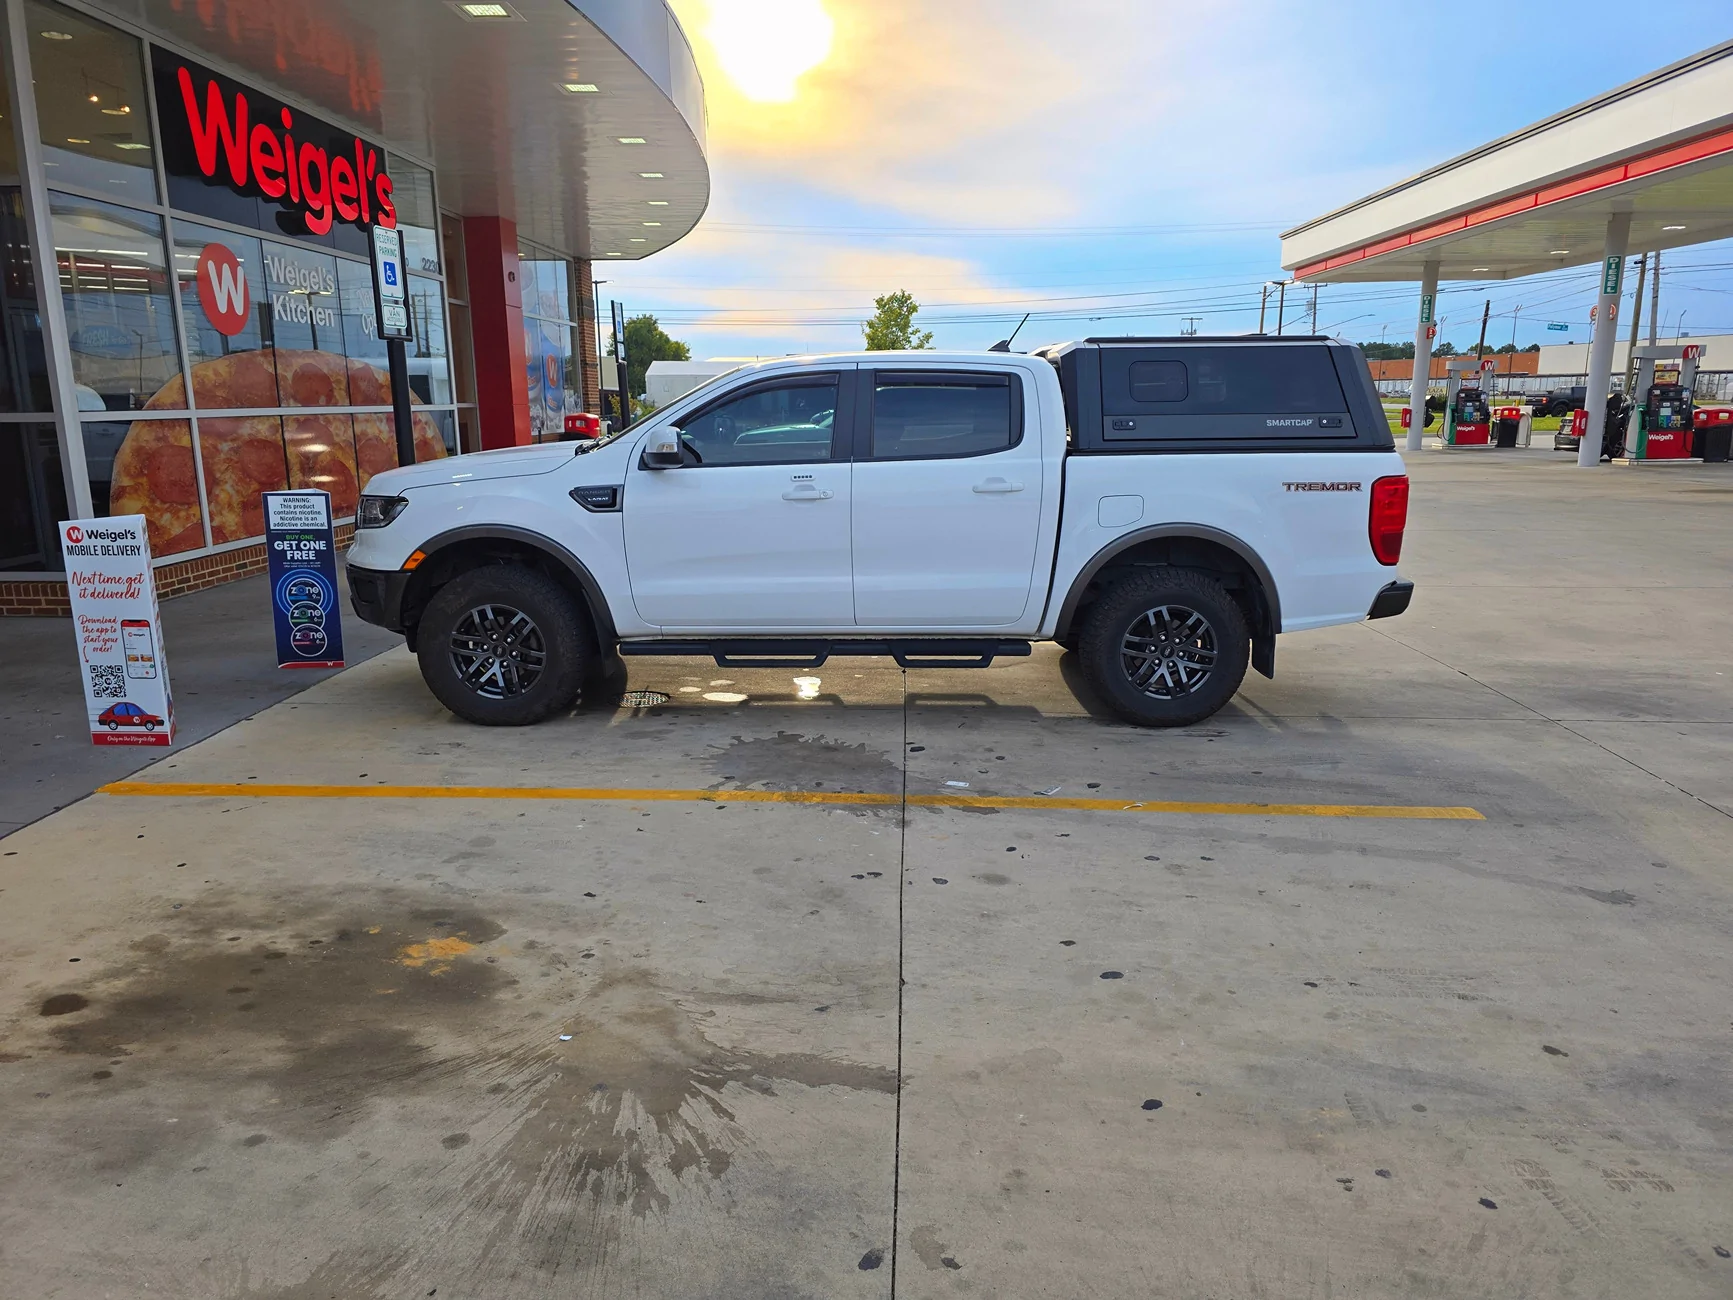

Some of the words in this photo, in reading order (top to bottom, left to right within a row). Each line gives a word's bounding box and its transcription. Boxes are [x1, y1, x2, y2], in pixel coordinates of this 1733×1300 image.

[178, 67, 397, 235] Weigel's
[376, 233, 398, 246] RESERVED
[379, 245, 397, 258] PARKING
[267, 255, 335, 293] Weigel's
[1606, 257, 1619, 293] DIESEL
[208, 260, 244, 315] W
[272, 294, 335, 327] Kitchen
[1422, 295, 1431, 322] DIESEL
[1688, 347, 1700, 359] W
[1485, 362, 1494, 371] W
[1266, 419, 1313, 427] SMARTCAP
[1282, 482, 1362, 492] TREMOR
[71, 529, 82, 540] W
[86, 529, 136, 542] Weigel's
[66, 545, 99, 556] MOBILE
[101, 545, 141, 556] DELIVERY
[274, 541, 298, 550] GET
[300, 541, 327, 550] ONE
[286, 551, 316, 560] FREE
[72, 571, 96, 586] Next
[124, 573, 144, 590] get
[79, 587, 89, 599] it
[90, 588, 141, 599] delivered!
[78, 614, 118, 625] Download
[82, 625, 95, 633] the
[95, 627, 109, 635] app
[110, 625, 117, 633] to
[84, 635, 101, 643] start
[102, 637, 118, 646] your
